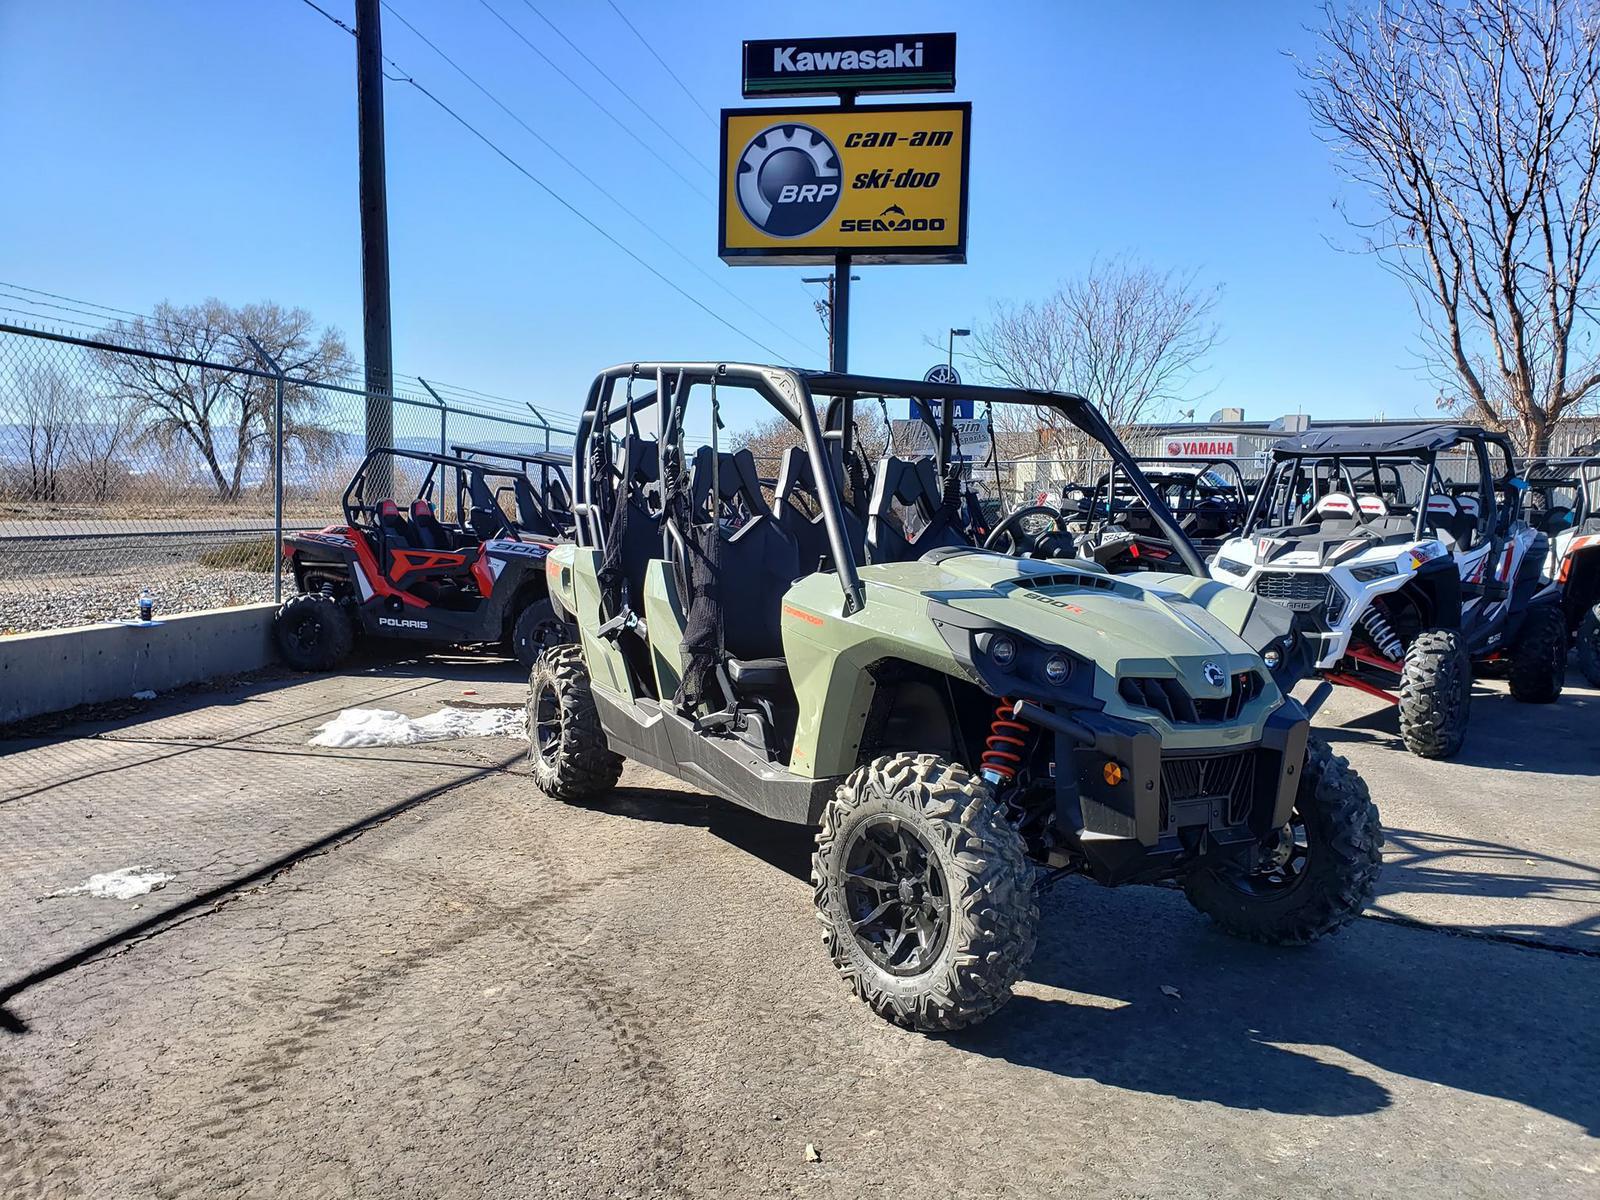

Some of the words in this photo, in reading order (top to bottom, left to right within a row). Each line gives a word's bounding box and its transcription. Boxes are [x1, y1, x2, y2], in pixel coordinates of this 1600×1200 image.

[773, 42, 923, 72] Kawasaki
[844, 130, 953, 148] can-am
[852, 168, 940, 189] ski-doo
[777, 184, 838, 203] BRP
[1182, 441, 1234, 455] YAMAHA
[491, 542, 547, 556] 900
[1023, 592, 1083, 613] 800R
[379, 617, 428, 629] POLARIS
